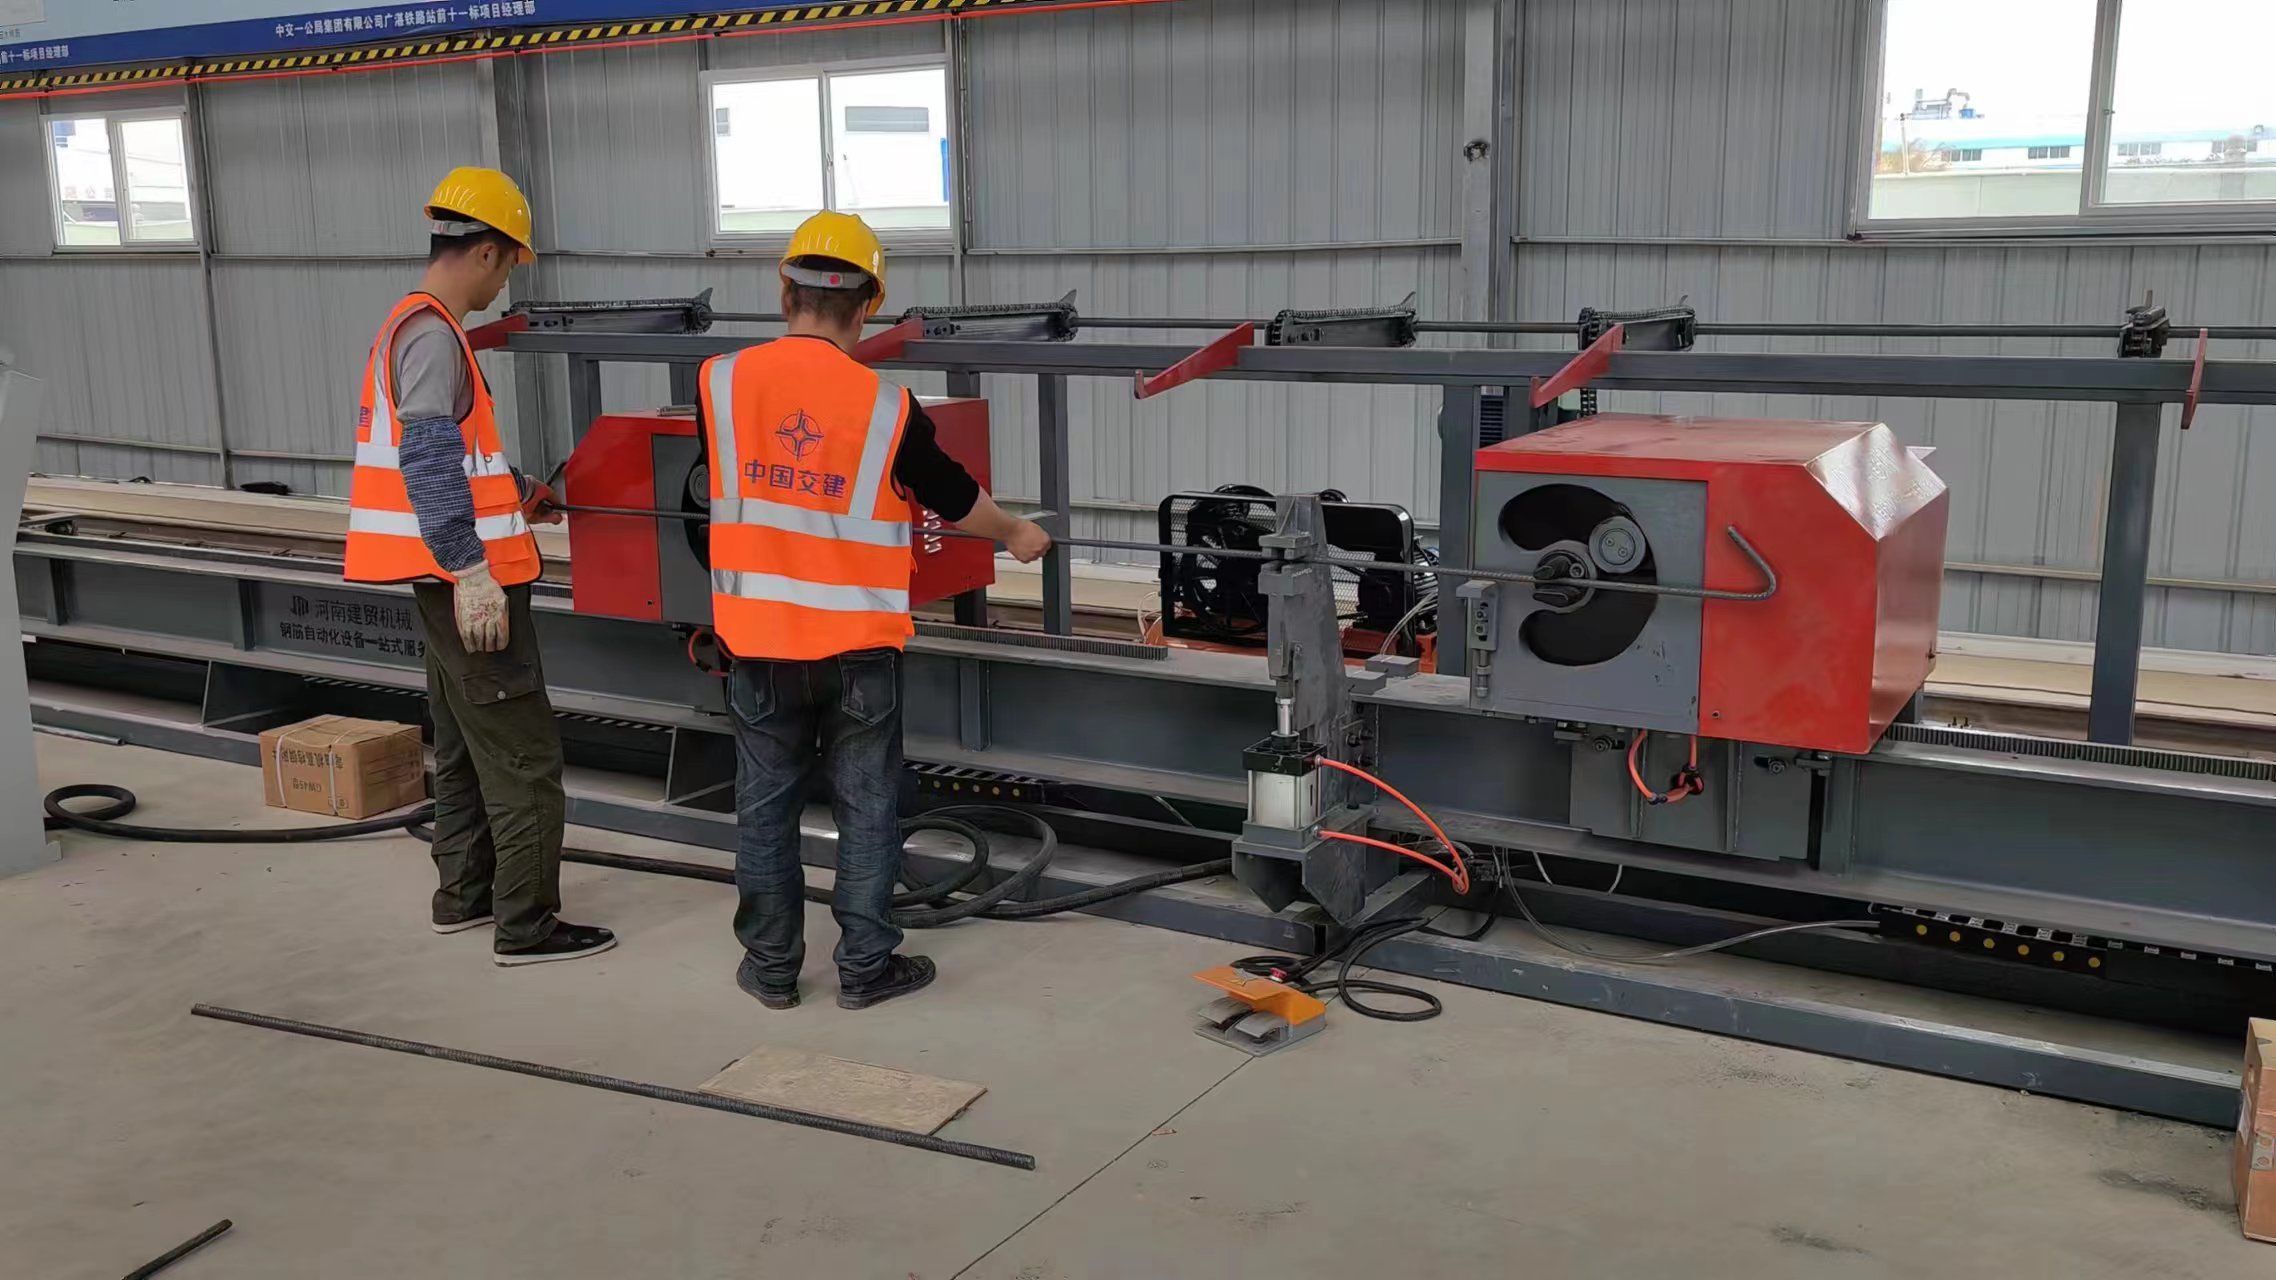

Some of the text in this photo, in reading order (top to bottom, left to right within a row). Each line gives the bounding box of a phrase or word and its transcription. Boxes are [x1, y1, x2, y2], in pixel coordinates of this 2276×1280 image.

[0, 45, 69, 64] 前十一标项目经理部
[745, 460, 846, 498] 中国交建
[315, 599, 413, 631] 河南建贸机械
